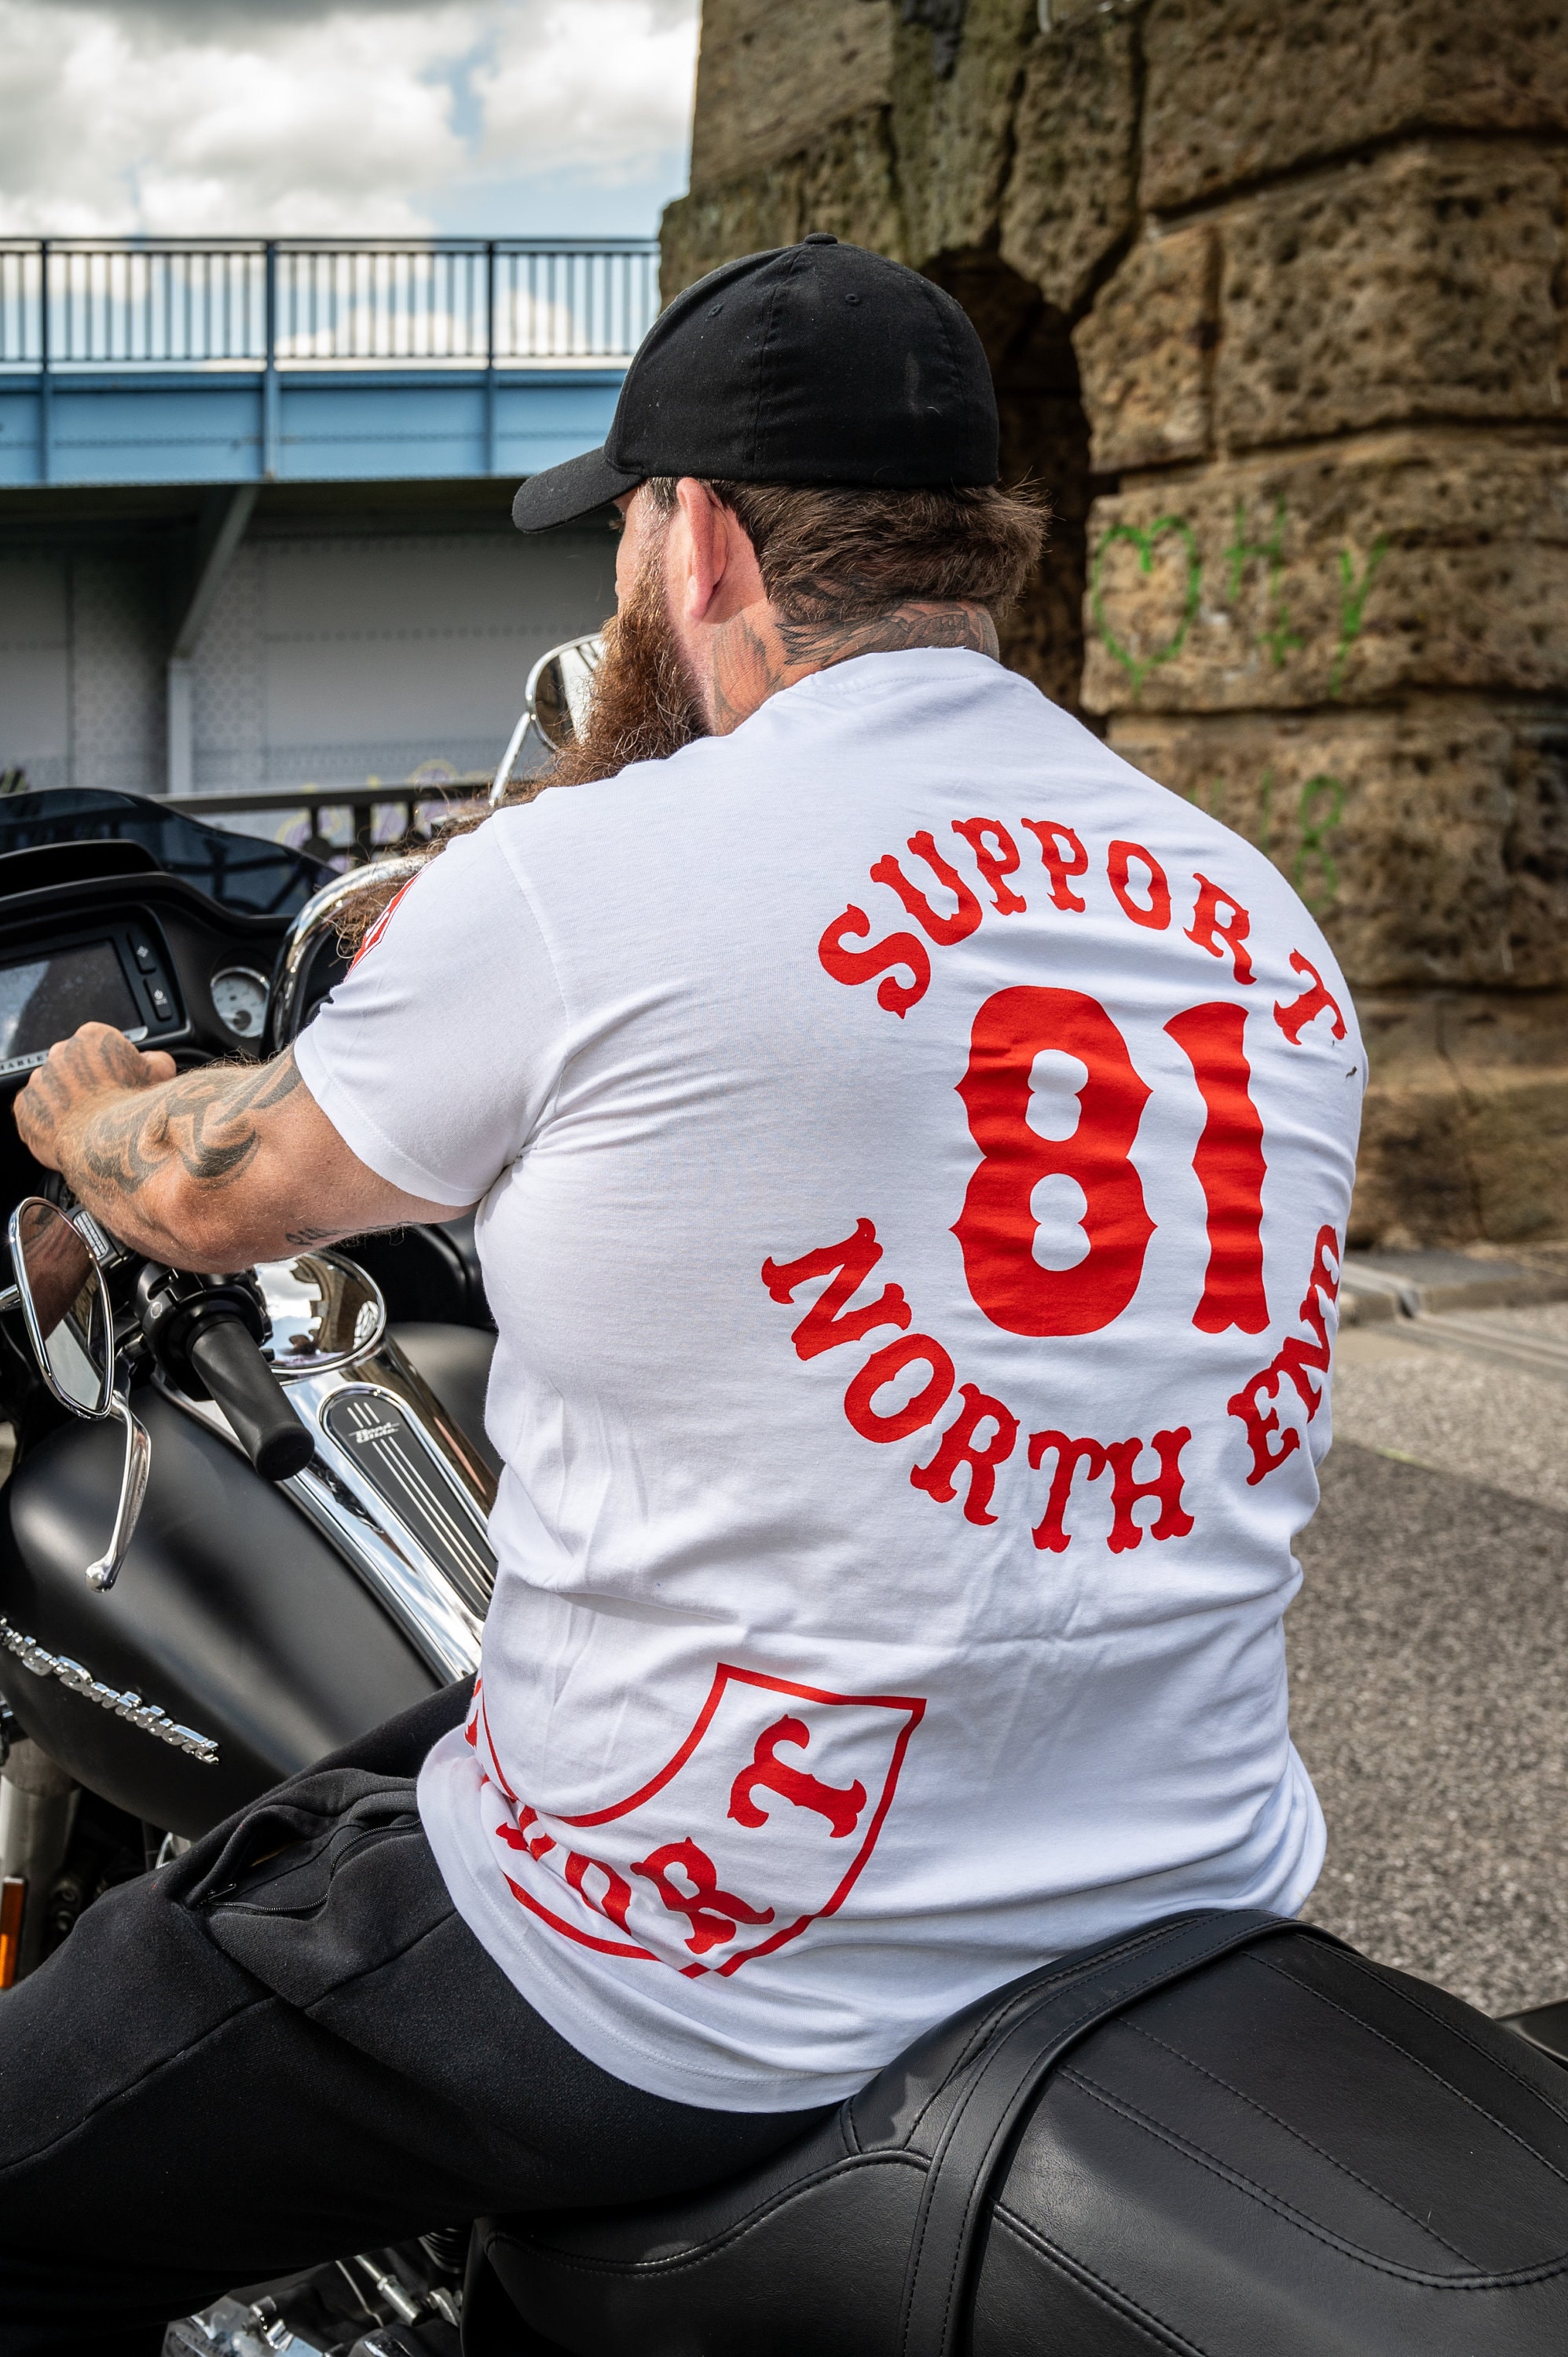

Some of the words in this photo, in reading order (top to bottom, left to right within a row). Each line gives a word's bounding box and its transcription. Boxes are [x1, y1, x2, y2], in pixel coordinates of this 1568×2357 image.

[818, 816, 1347, 1046] SUPPORT
[949, 984, 1270, 1338] 81
[760, 1217, 1195, 1554] NORTH
